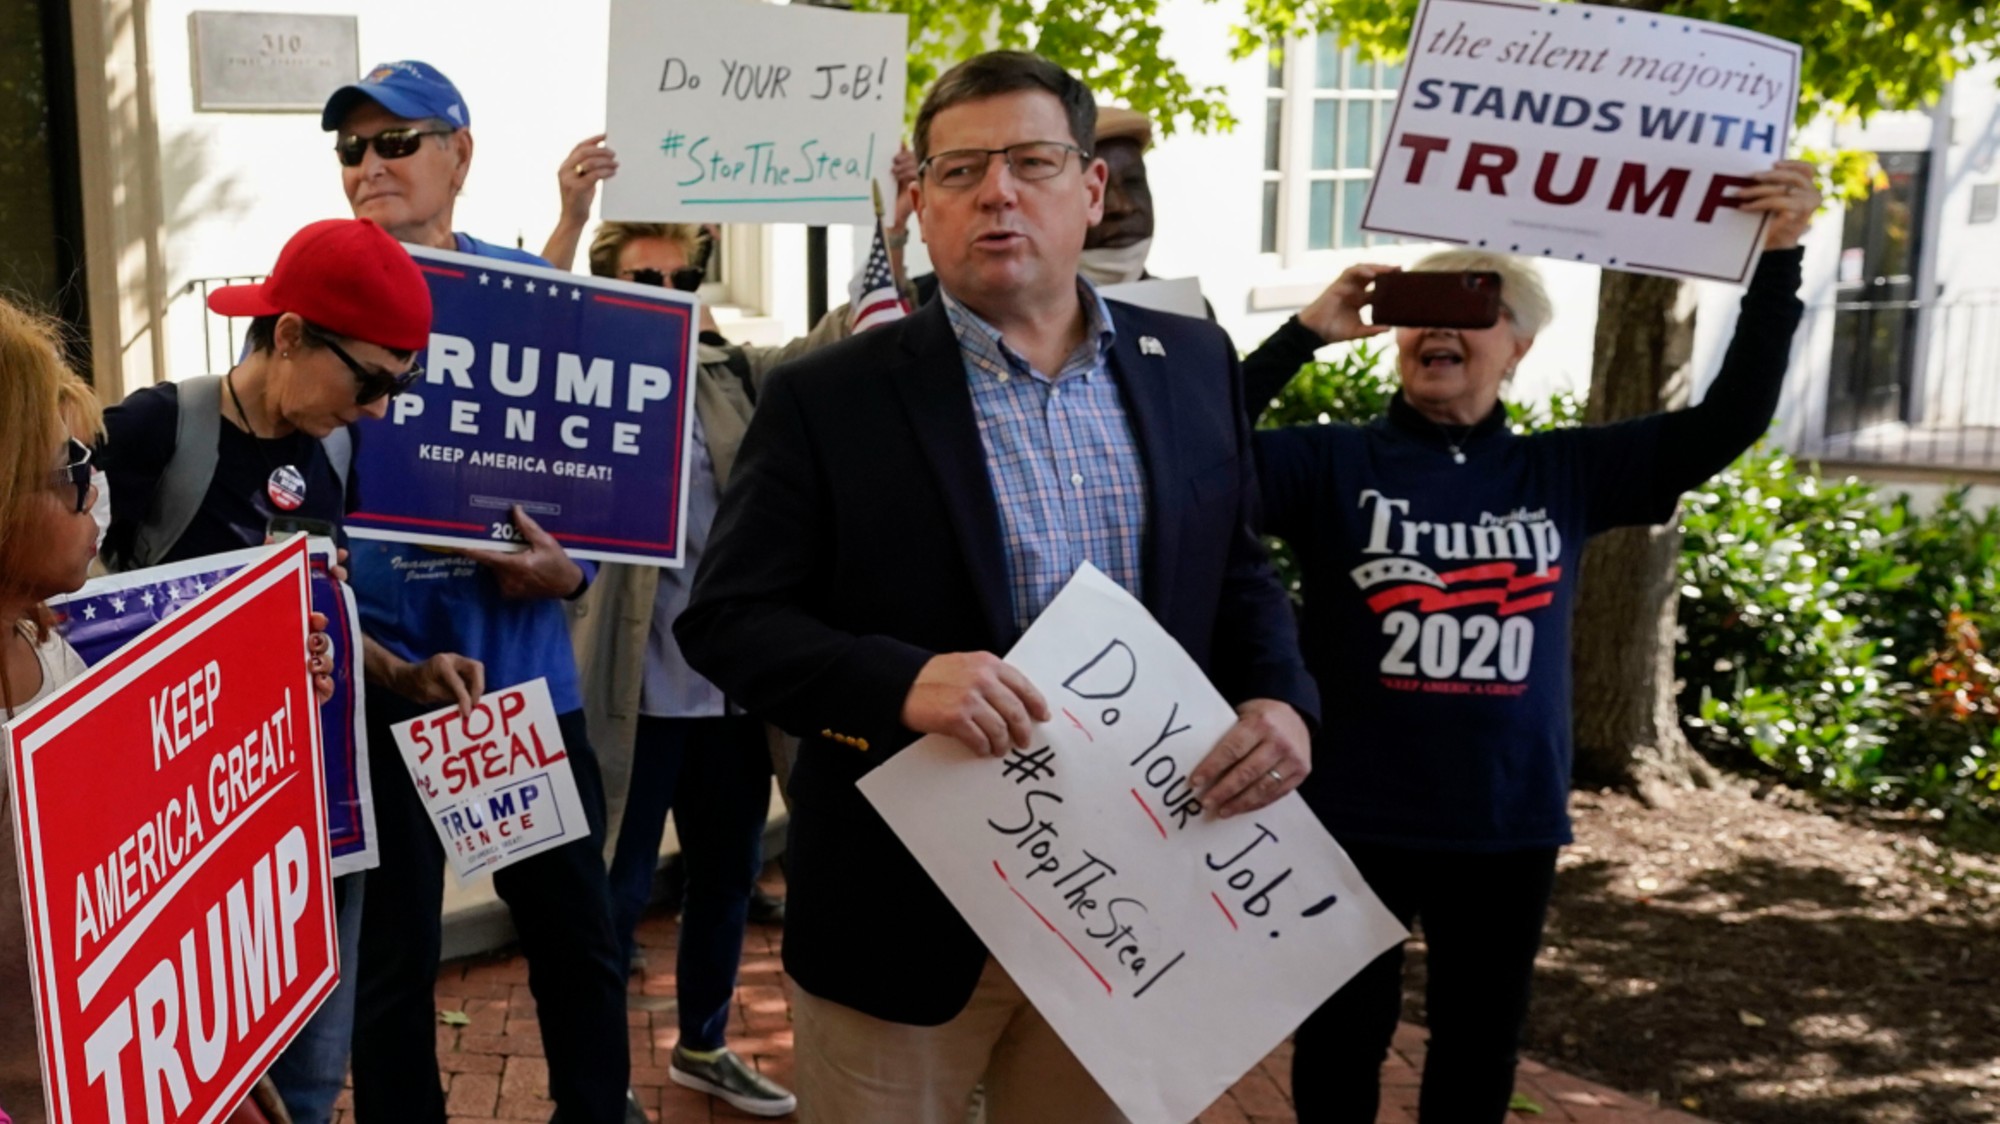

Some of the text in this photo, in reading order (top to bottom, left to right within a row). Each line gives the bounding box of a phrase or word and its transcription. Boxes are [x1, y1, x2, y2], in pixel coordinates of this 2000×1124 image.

[260, 32, 302, 57] 310
[721, 59, 791, 101] YOUR
[1427, 22, 1785, 109] the silent majority
[1413, 78, 1776, 155] STANDS WITH
[659, 130, 875, 187] #StopTheSteal
[426, 332, 672, 413] RUMP
[393, 393, 642, 455] PENCE
[419, 443, 613, 481] KEEP AMERICA GREAT!
[1358, 488, 1561, 577] Trump
[1379, 610, 1534, 682] 2020
[148, 659, 221, 771] KEEP
[409, 691, 526, 764] STOP
[441, 722, 568, 795] STEAL
[1062, 638, 1338, 939] Do YOUR Job!
[74, 687, 296, 962] AMERICA GREAT!
[83, 825, 310, 1124] TRUMP
